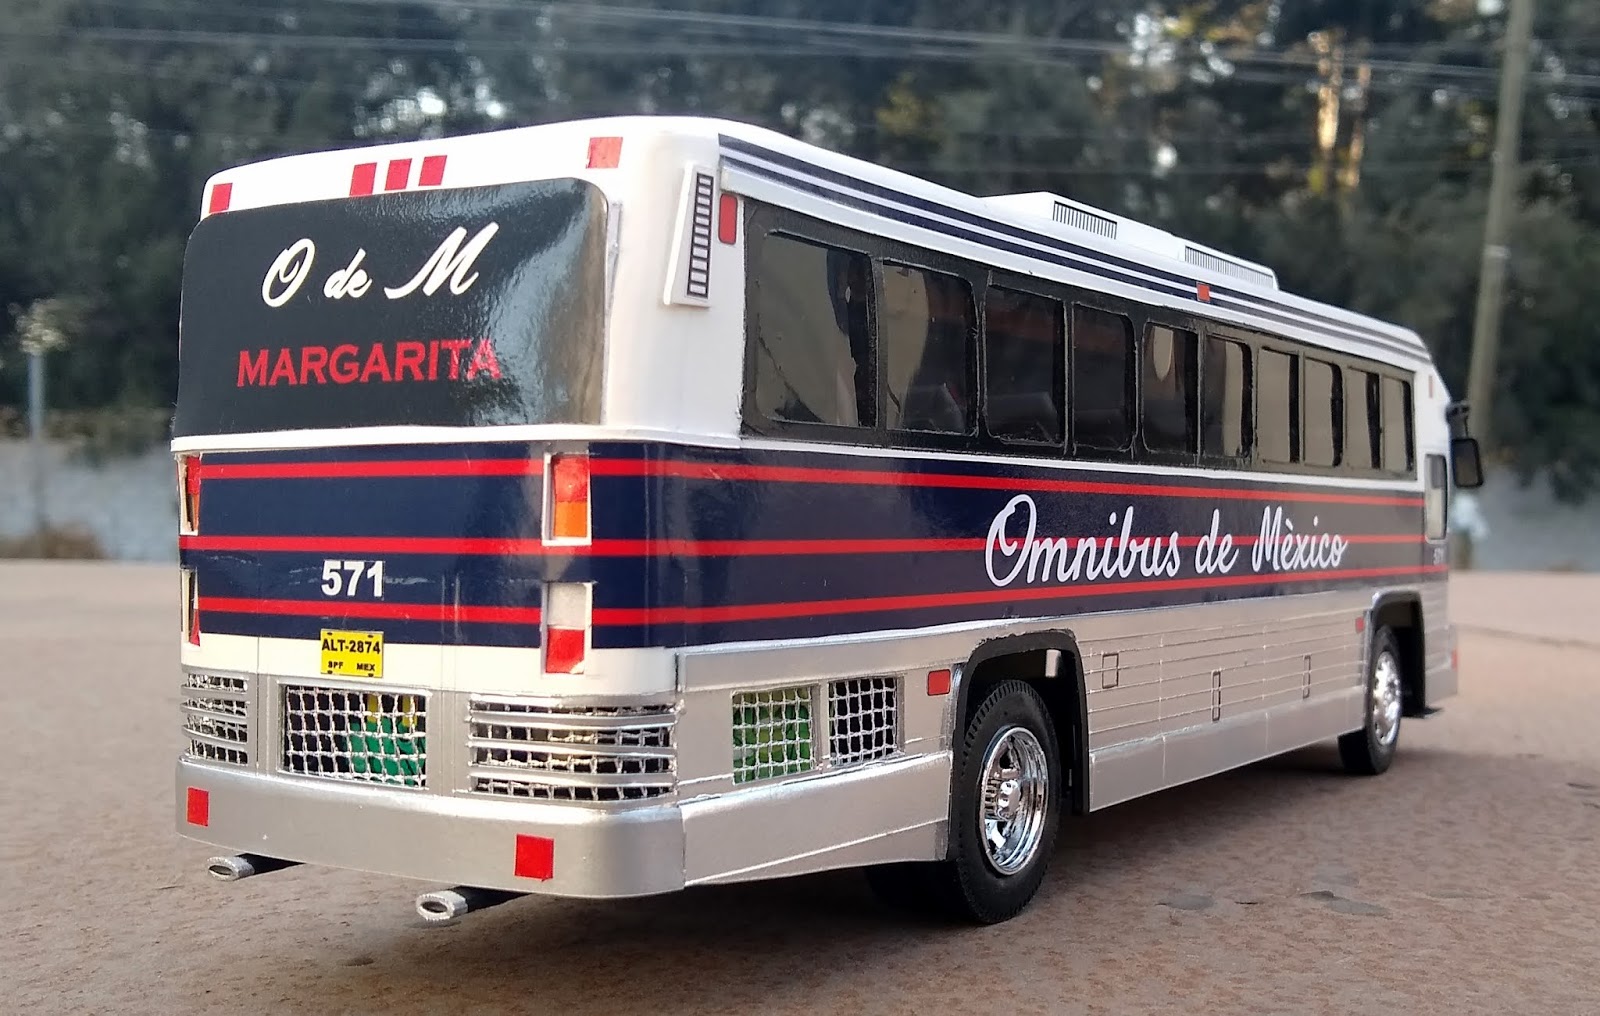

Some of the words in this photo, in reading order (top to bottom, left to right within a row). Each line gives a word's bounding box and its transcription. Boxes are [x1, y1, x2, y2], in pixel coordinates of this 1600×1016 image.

[262, 238, 315, 307] O
[324, 248, 372, 299] de
[384, 222, 499, 299] M
[237, 338, 502, 387] MARGARITA
[985, 494, 1180, 587] Omnibus
[1195, 508, 1240, 574] de
[321, 560, 383, 597] 571
[322, 639, 381, 654] ALT-2874
[356, 663, 376, 672] MEX
